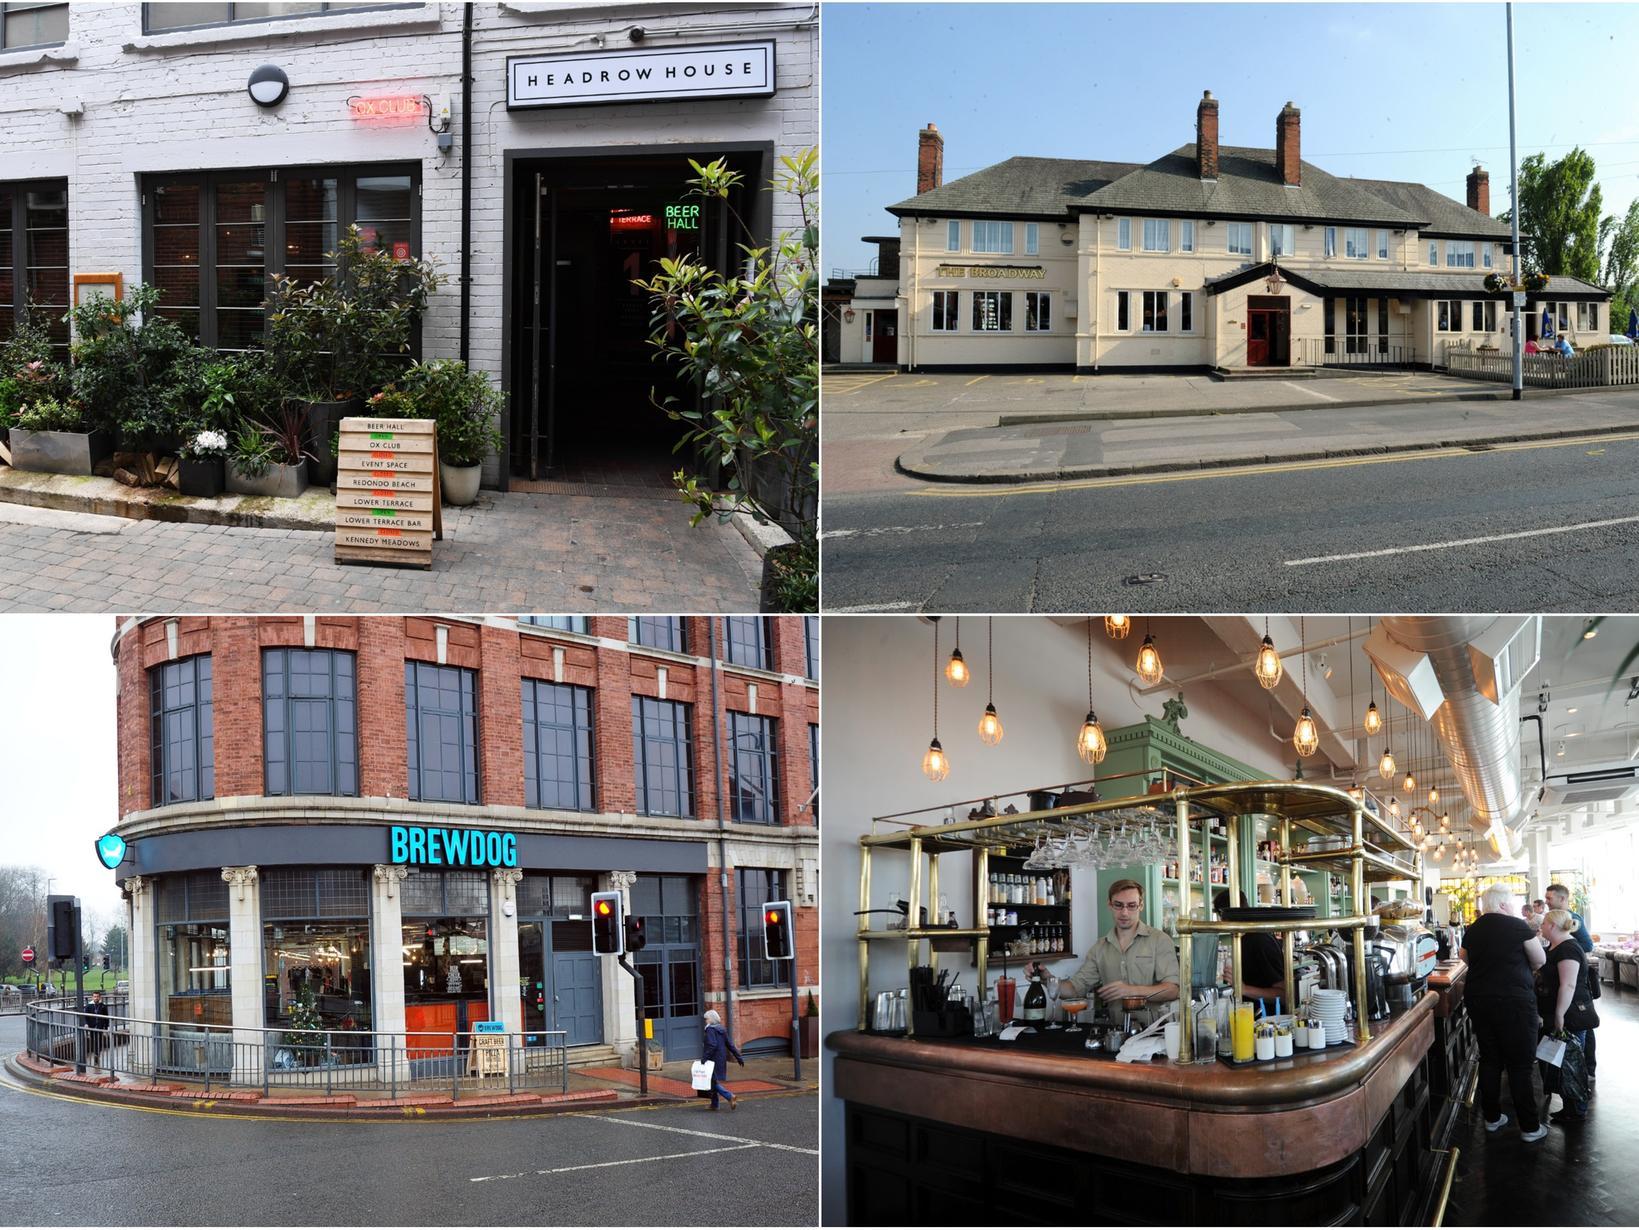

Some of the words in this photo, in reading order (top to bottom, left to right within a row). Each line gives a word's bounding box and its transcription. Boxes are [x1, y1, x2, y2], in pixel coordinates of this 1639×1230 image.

[528, 68, 652, 86] HEADROW
[666, 62, 752, 79] HOUSE
[356, 101, 375, 115] OX
[379, 98, 416, 113] CLUB
[665, 205, 700, 217] BEER
[667, 218, 699, 229] HALL
[936, 267, 965, 278] THE
[969, 267, 1046, 279] BROADWAY
[373, 518, 404, 526] TERRACE
[345, 536, 379, 544] KENNEDY
[381, 538, 420, 547] MEADOWS
[391, 826, 517, 867] BREWDOG
[479, 1037, 493, 1045] CRAFT
